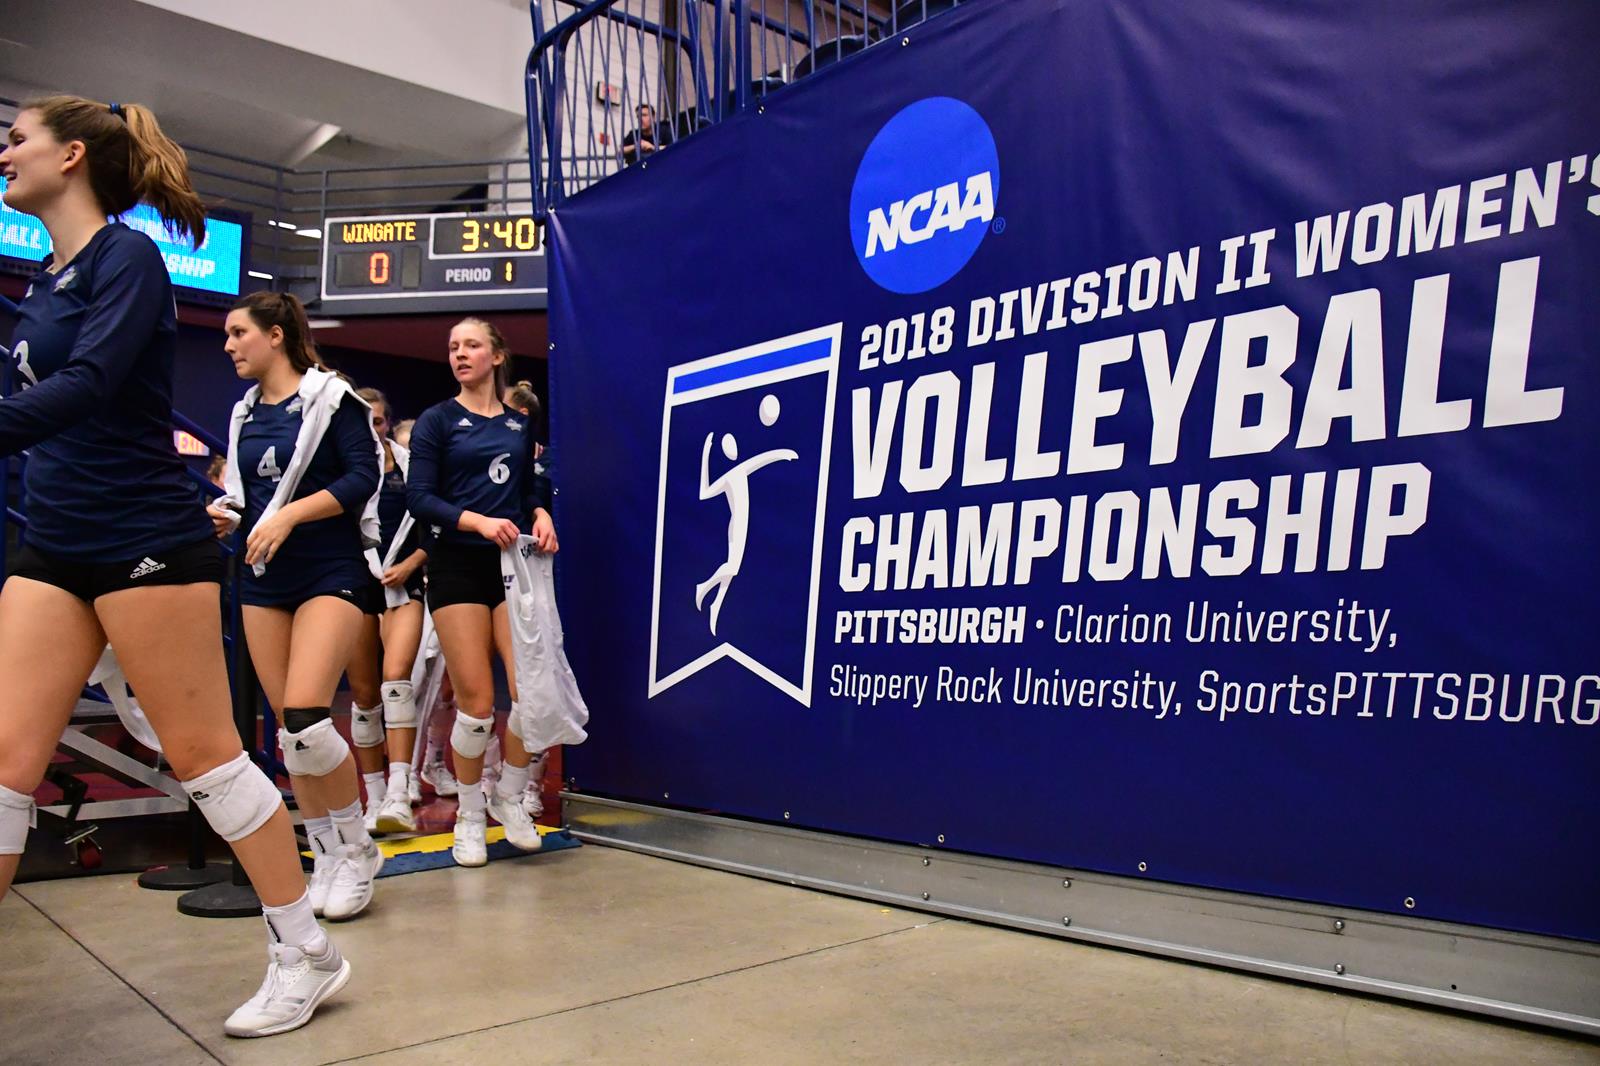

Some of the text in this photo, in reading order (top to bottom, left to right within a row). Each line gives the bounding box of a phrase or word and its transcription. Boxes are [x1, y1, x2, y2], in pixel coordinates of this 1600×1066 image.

[343, 222, 416, 243] WINGATE
[462, 218, 535, 252] 3:40
[865, 171, 994, 258] NCAA
[369, 252, 390, 284] 0
[445, 261, 513, 283] PERIOD 1
[859, 306, 955, 370] 2018
[967, 246, 1200, 348] DIVISION
[1216, 228, 1275, 294] II
[852, 256, 1564, 499] VOLLEYBALL
[257, 445, 281, 482] 4
[488, 453, 511, 484] 6
[839, 463, 1431, 592] CHAMPIONSHIP
[835, 599, 1396, 653] PITTSBURGH Clarion University,
[830, 664, 928, 707] Slippery
[937, 667, 1003, 703] Rock
[1013, 668, 1181, 719] University,
